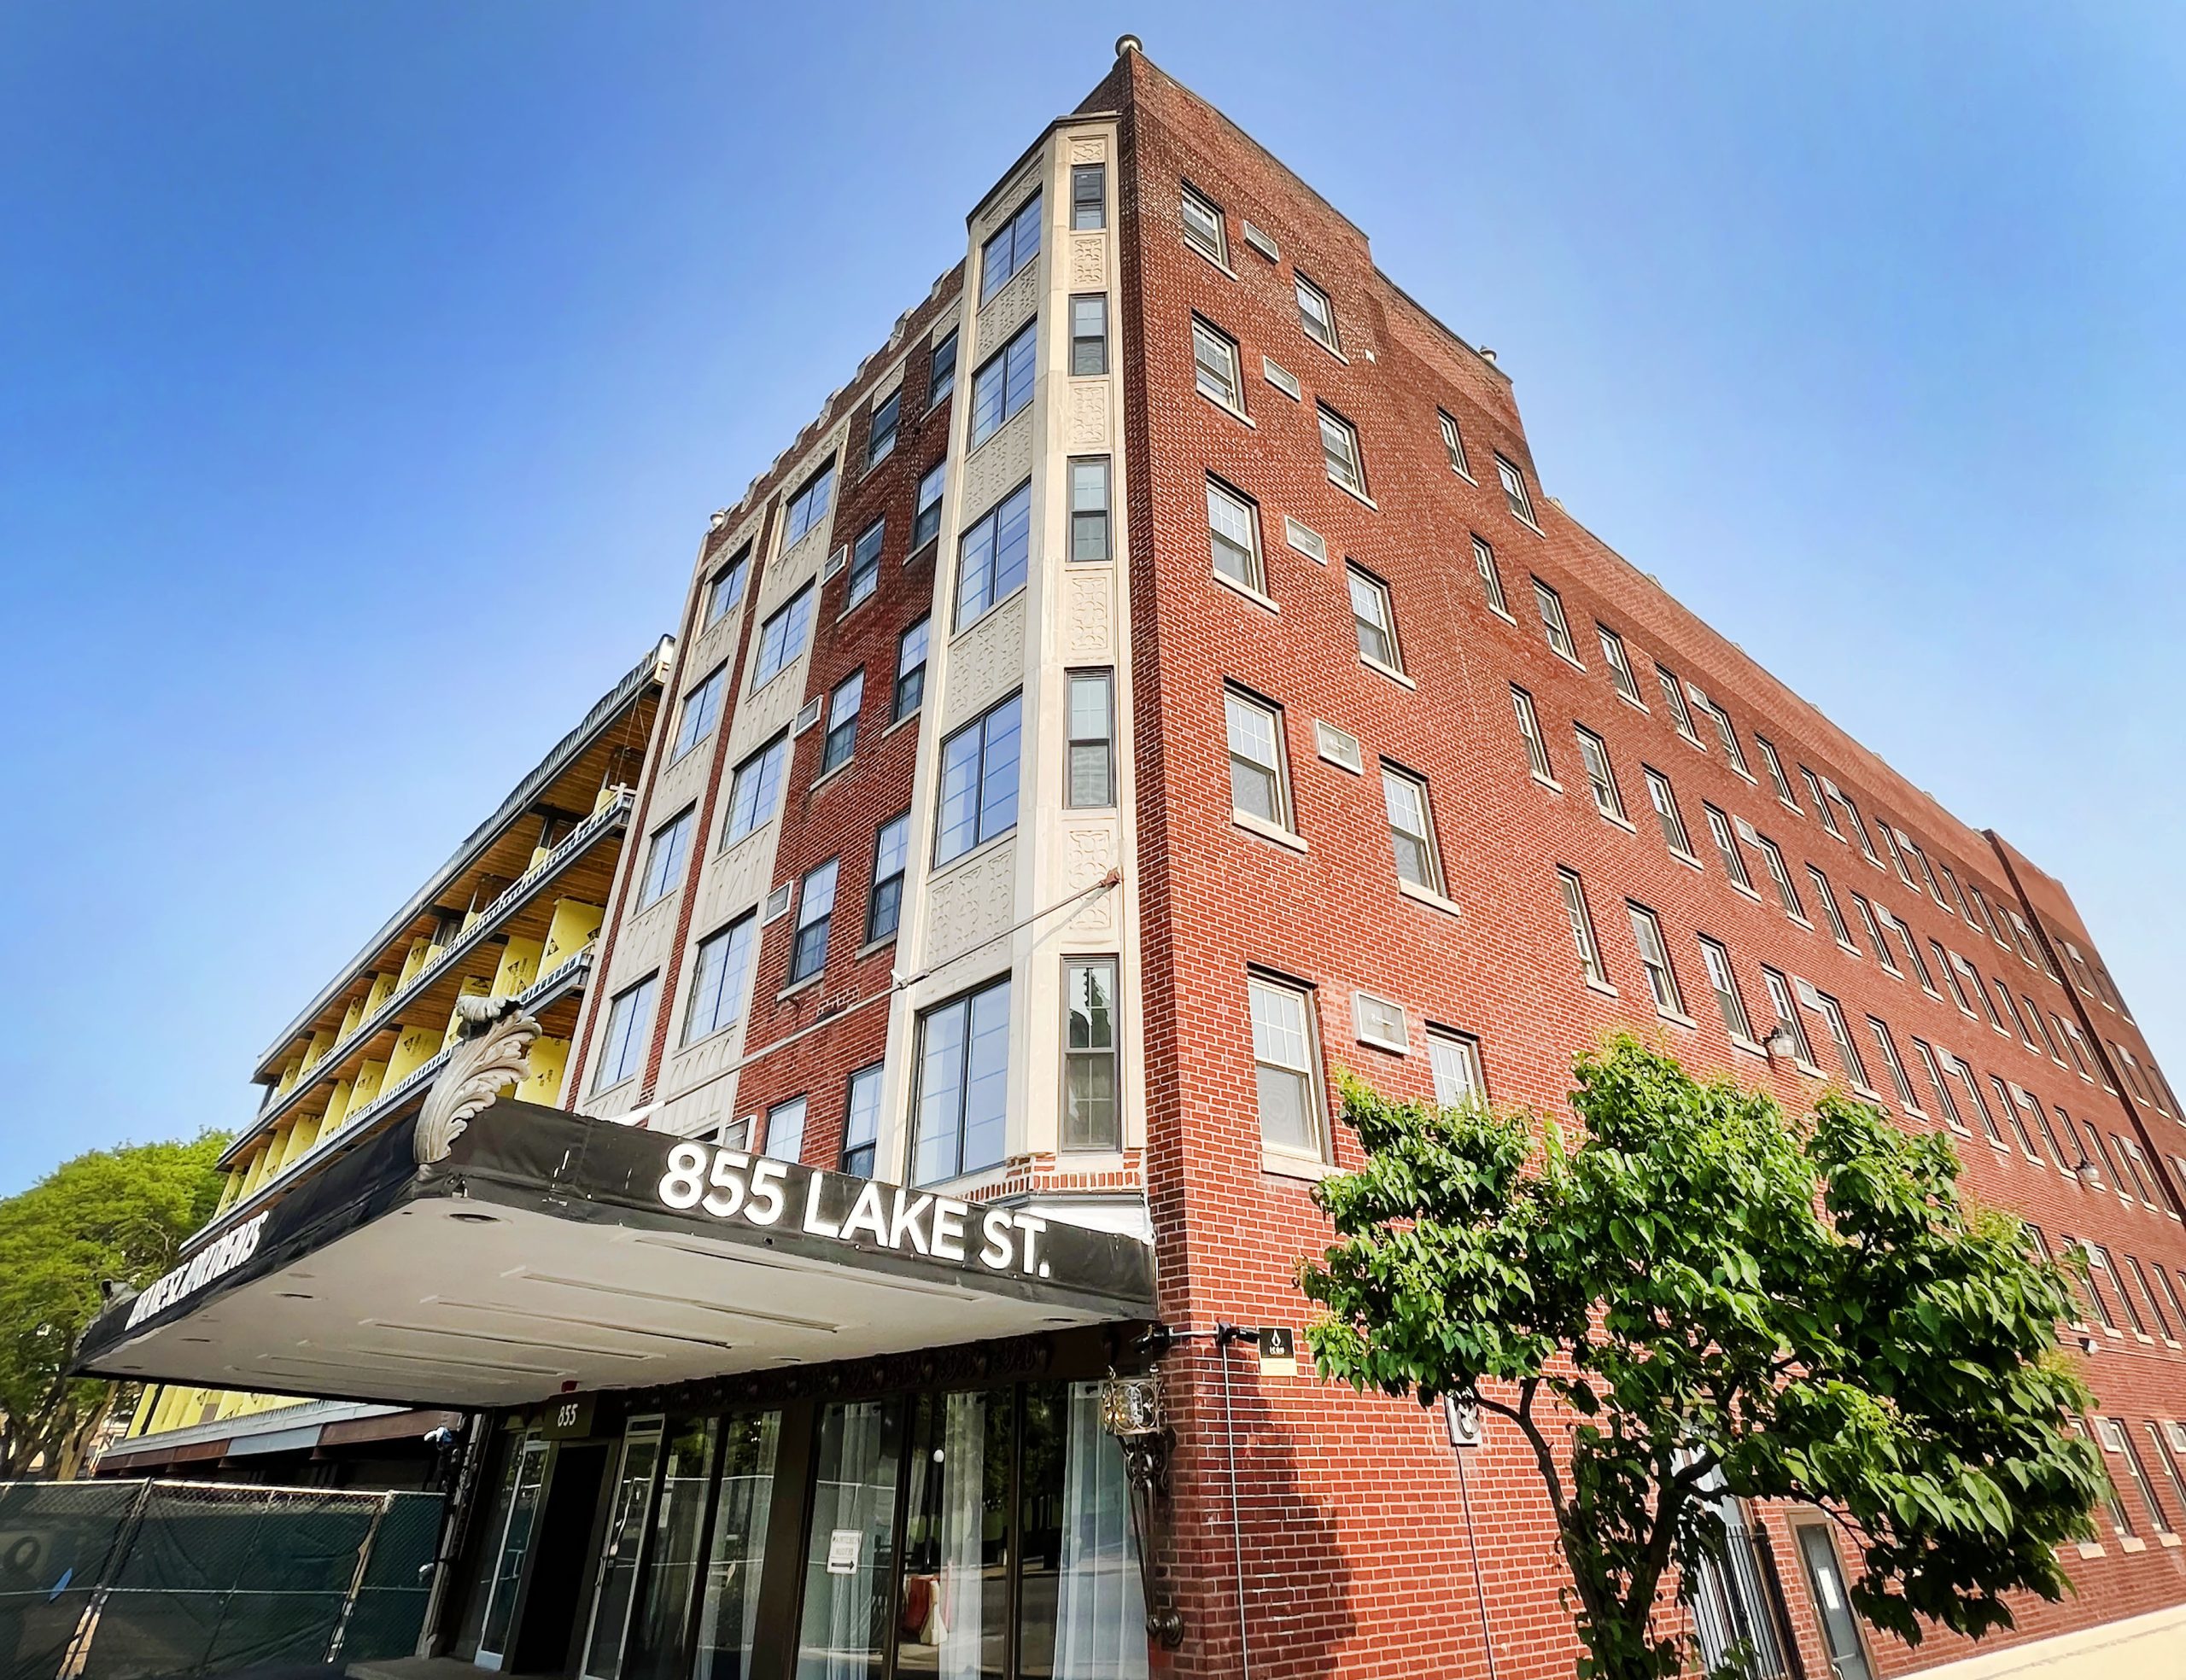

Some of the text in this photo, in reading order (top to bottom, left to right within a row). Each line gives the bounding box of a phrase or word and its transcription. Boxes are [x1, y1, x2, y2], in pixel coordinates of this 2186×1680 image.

[658, 1142, 1050, 1279] 855 LAKE ST.
[557, 1403, 579, 1427] 855
